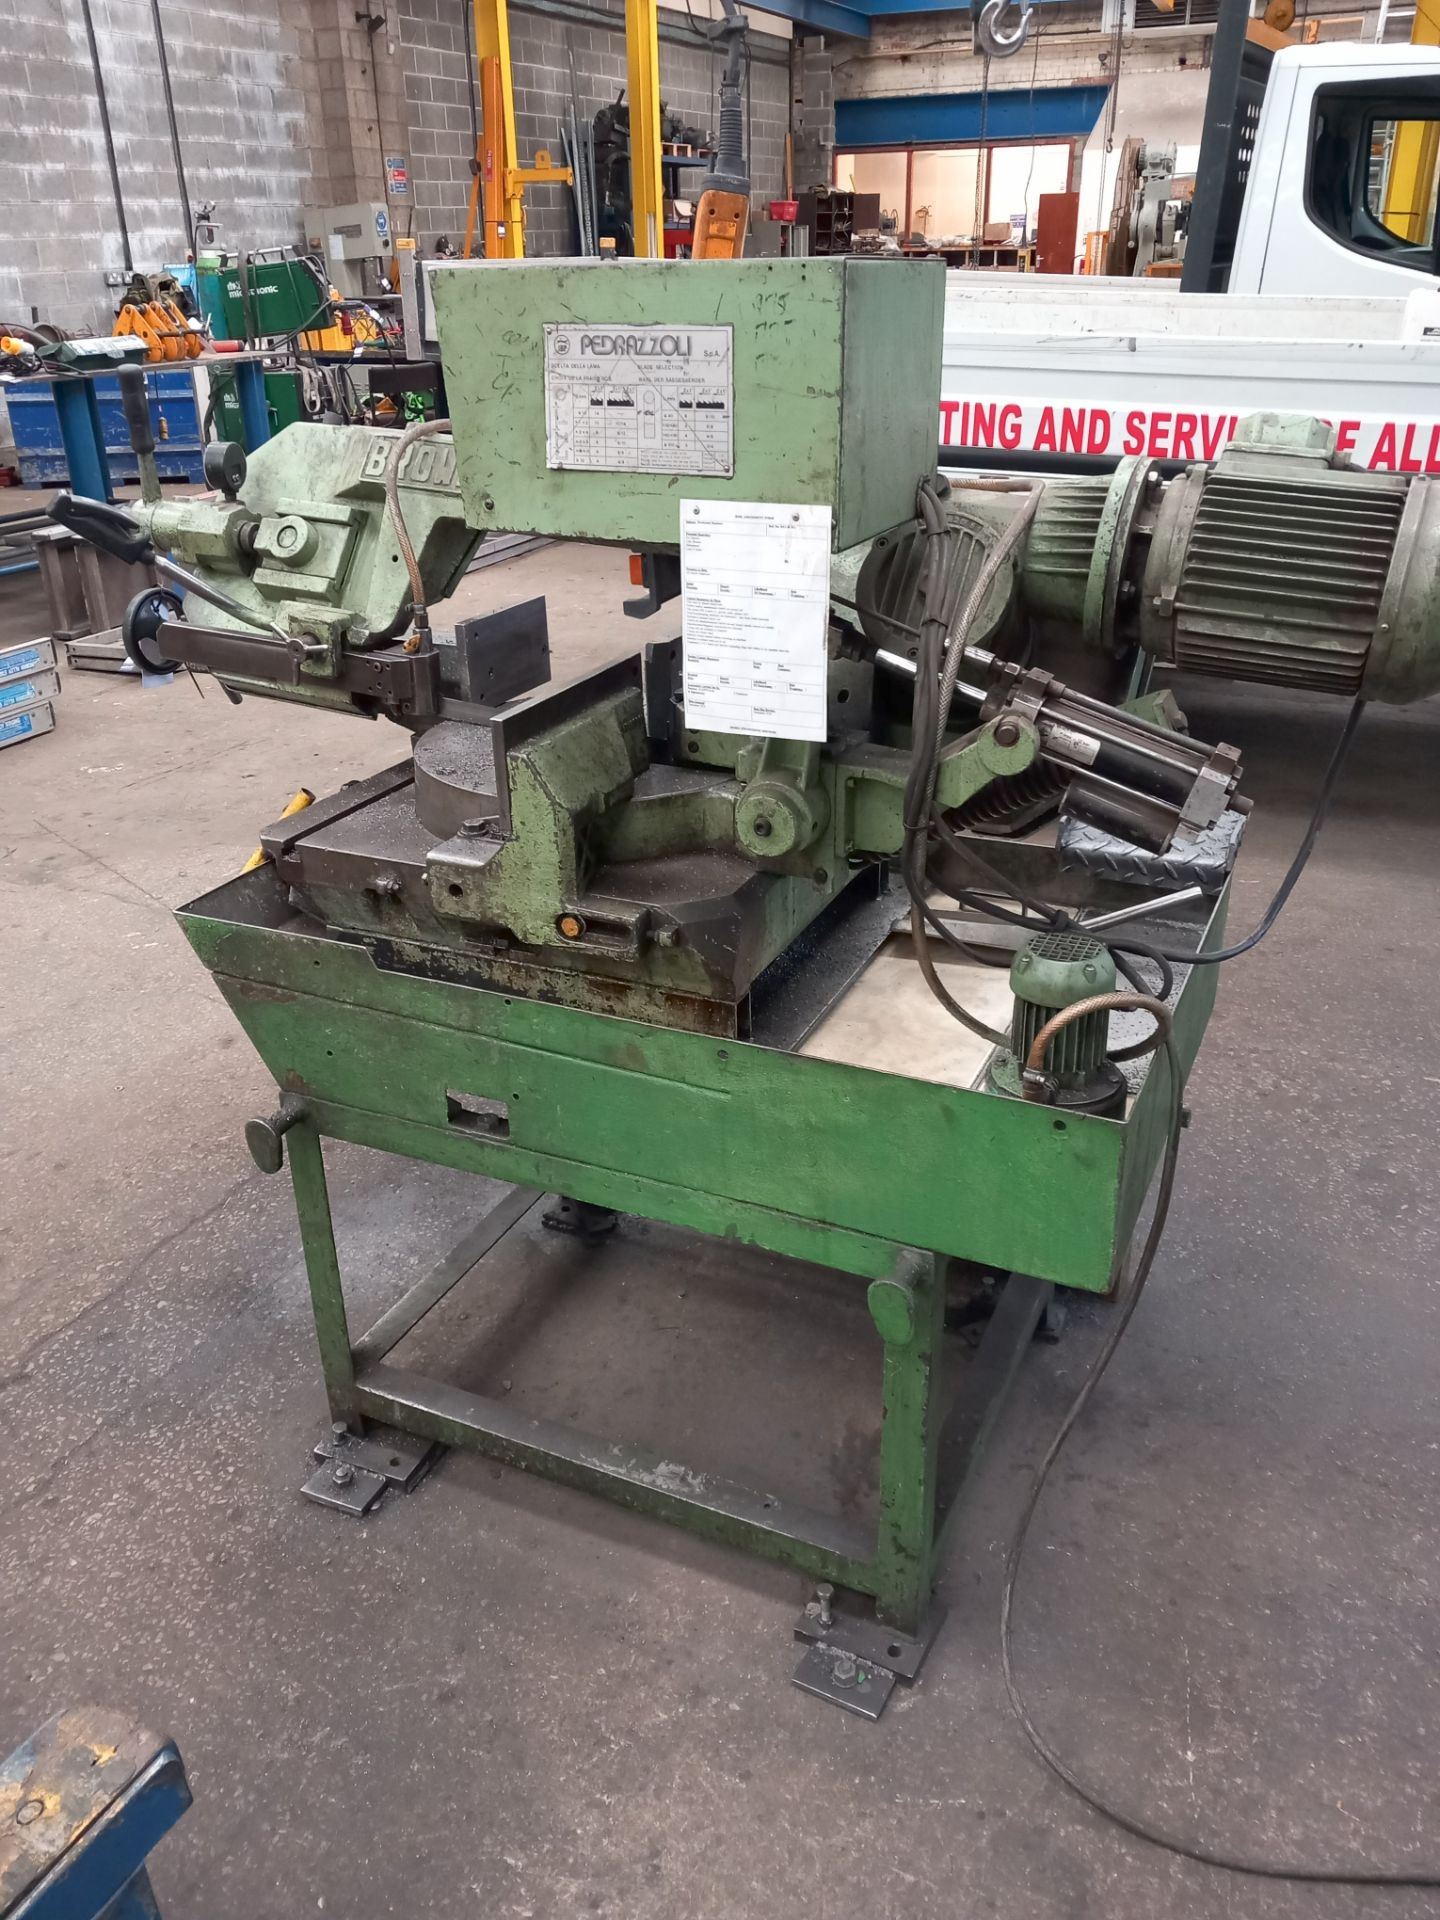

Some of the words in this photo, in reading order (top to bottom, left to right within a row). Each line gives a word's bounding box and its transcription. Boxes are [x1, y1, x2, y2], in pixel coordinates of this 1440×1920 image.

[580, 334, 692, 356] PEDRAZZOLI
[939, 400, 1022, 450] TING
[1033, 405, 1111, 455] AND
[1123, 410, 1238, 461] SERVI
[1367, 421, 1440, 473] ALL
